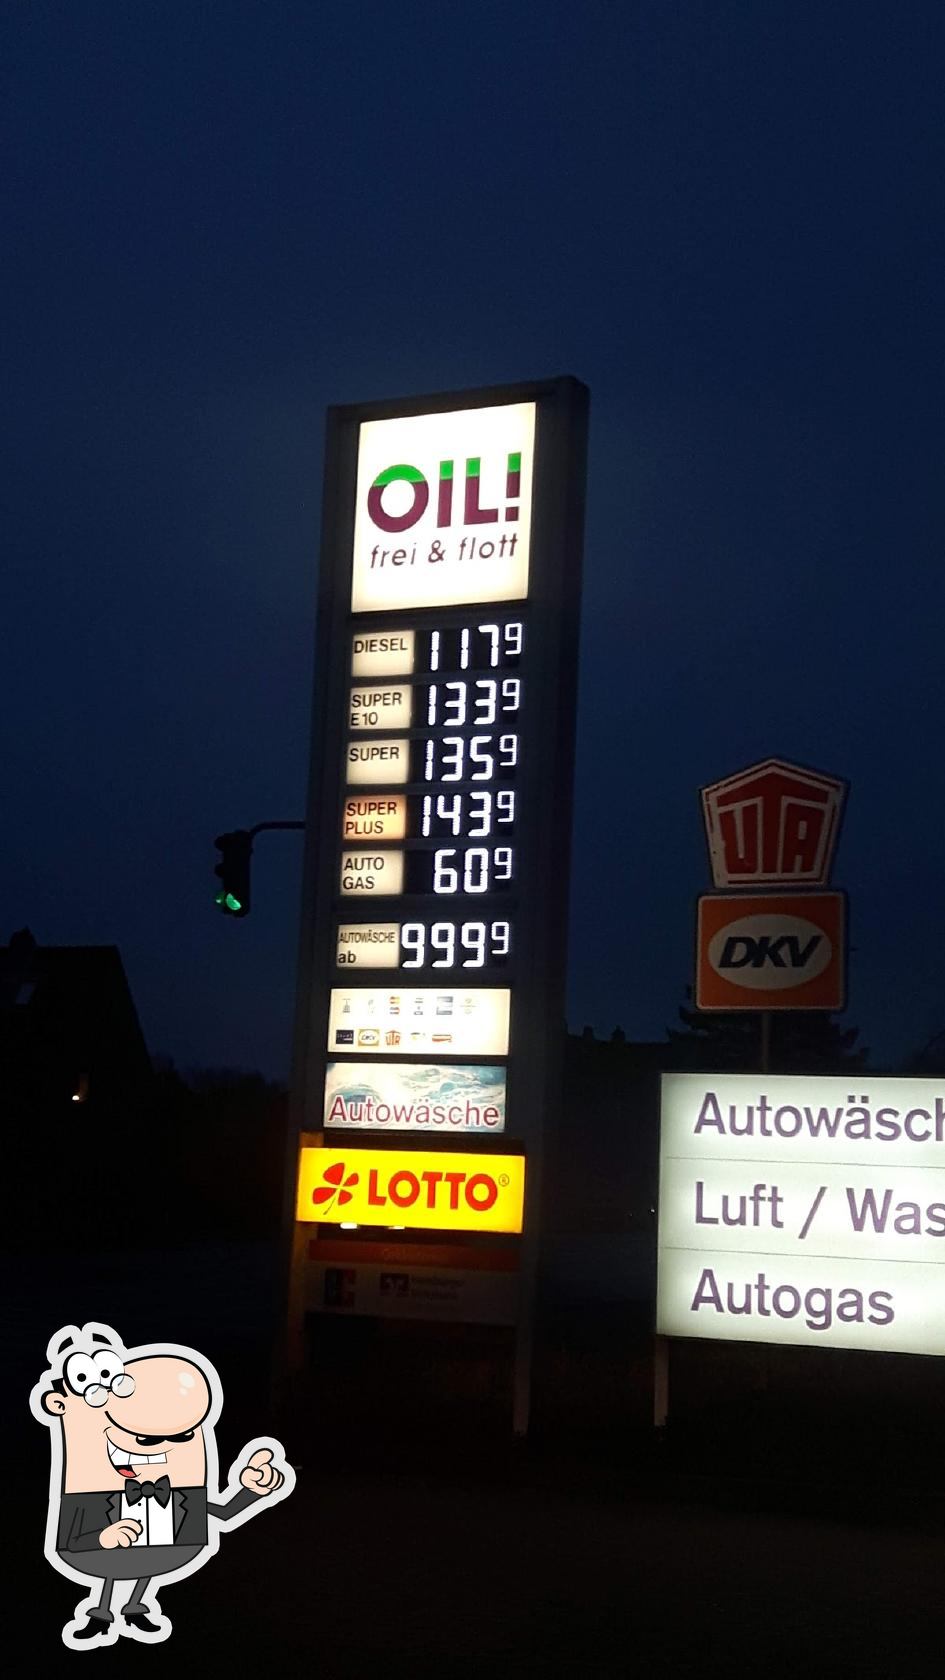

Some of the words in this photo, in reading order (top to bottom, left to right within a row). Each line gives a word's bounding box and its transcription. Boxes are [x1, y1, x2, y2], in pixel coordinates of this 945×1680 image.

[367, 452, 522, 533] OIL!
[370, 542, 417, 568] frei
[427, 539, 446, 564] &
[458, 533, 519, 561] flott
[353, 637, 409, 655] DIESEL
[351, 691, 403, 709] SUPER
[350, 711, 379, 727] E10
[348, 746, 401, 763] SUPER
[345, 801, 398, 818] SUPER
[344, 820, 385, 836] PLUS
[343, 856, 386, 873] AUTO
[342, 875, 376, 891] GAS
[338, 929, 396, 945] AUTOWÄSCHE
[337, 950, 358, 965] ab
[718, 935, 823, 969] DKV
[328, 1096, 500, 1127] Autowäsche
[695, 1181, 785, 1229] Luft
[797, 1185, 829, 1241] /
[845, 1187, 945, 1238] Was
[690, 1268, 896, 1332] Autogas
